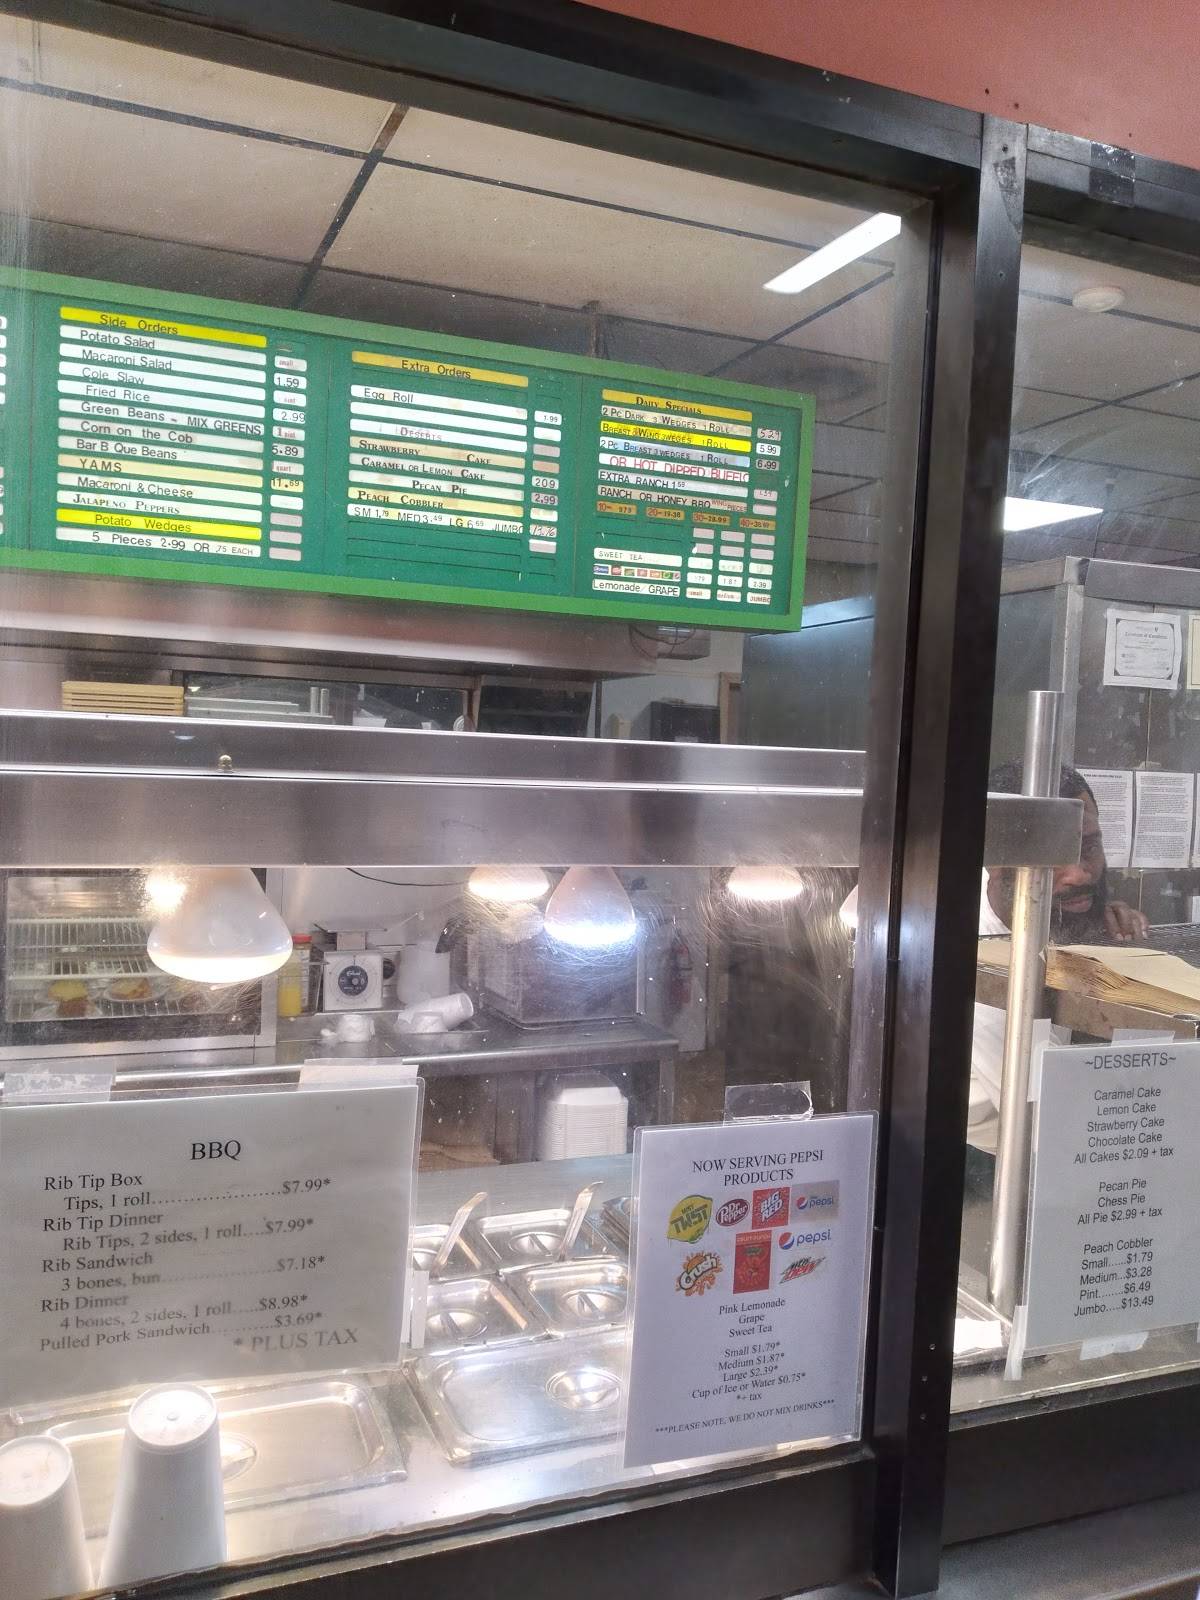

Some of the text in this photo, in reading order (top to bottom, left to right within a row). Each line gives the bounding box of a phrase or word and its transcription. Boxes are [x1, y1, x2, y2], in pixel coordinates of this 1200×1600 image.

[100, 314, 178, 334] Side Orders
[80, 330, 155, 349] Potato Salad
[82, 349, 172, 370] Macaroni Salad
[82, 367, 144, 385] Cole Slaw
[401, 360, 471, 379] Extra Orders
[277, 377, 299, 388] 1.59
[86, 385, 150, 401] Fried Rice
[364, 388, 413, 403] Egg Roll
[81, 402, 261, 435] Green Beans MIX GREENS
[281, 411, 305, 423] 2.99
[624, 411, 644, 420] DARK
[662, 416, 696, 428] WEDGES
[709, 423, 729, 433] ROLL
[81, 421, 193, 444] Corn on the Cob
[77, 439, 177, 460] Bar B Que Beans
[272, 445, 298, 456] 5.89
[79, 459, 122, 472] YAMS
[467, 454, 491, 465] CAKE
[634, 459, 657, 471] HOT
[422, 463, 453, 476] LEMON
[461, 469, 485, 481] CAKE
[600, 472, 668, 487] EXTRA RANCH
[77, 477, 131, 492] Macaroni
[412, 480, 442, 492] PECAN
[358, 491, 444, 509] PEACH COBBLER
[600, 488, 632, 498] RANCH
[355, 508, 371, 517] SM
[95, 514, 192, 532] Potato Wedges
[92, 531, 100, 542] 5
[112, 533, 152, 547] Pieces
[193, 542, 209, 553] OR
[232, 546, 253, 555] EACH
[649, 585, 678, 596] GRAPE
[1095, 1087, 1161, 1101] Caramel Cake
[1097, 1103, 1156, 1116] Lemon Cake
[1088, 1117, 1164, 1132] Strawberry Cake
[1088, 1132, 1162, 1147] Chocolate Cake
[190, 1140, 241, 1161] BBQ
[1075, 1147, 1174, 1164] All Cakes $2.09 tax
[692, 1150, 824, 1172] NOW SERVING PEPSI
[44, 1173, 143, 1191] Rib Tip Box
[724, 1169, 794, 1186] PRODUCTS
[1099, 1178, 1146, 1192] Pecan Pie
[64, 1196, 103, 1213] Tips,
[809, 1196, 833, 1208] pepsi
[1098, 1194, 1145, 1208] Chess Pie
[720, 1202, 748, 1224] Dr Pepper
[1078, 1208, 1162, 1224] All Pie $2.99 tax
[43, 1213, 163, 1232] Rib Tip Dinner
[64, 1230, 197, 1250] Rib Tips, 2 sides,
[797, 1229, 831, 1246] pepsi
[1084, 1238, 1154, 1254] Peach Cobbler
[42, 1252, 153, 1272] Rib Sandwich
[680, 1256, 718, 1289] Crush
[62, 1277, 127, 1291] 3 bones,
[41, 1295, 129, 1312] Rib Dinner
[719, 1298, 786, 1315] Pink Lemonade
[145, 1308, 187, 1322] sides,
[739, 1313, 764, 1325] Grape
[252, 1328, 358, 1351] PLUS TAX
[729, 1325, 772, 1338] Sweet Tea
[40, 1331, 130, 1351] Pulled Pork
[724, 1346, 749, 1358] Small
[718, 1360, 753, 1371] Medium
[723, 1372, 747, 1383] Large
[692, 1378, 775, 1399] Cup of Ice or Water
[750, 1393, 762, 1401] tax
[729, 1406, 792, 1423] WE DO NOT MIX
